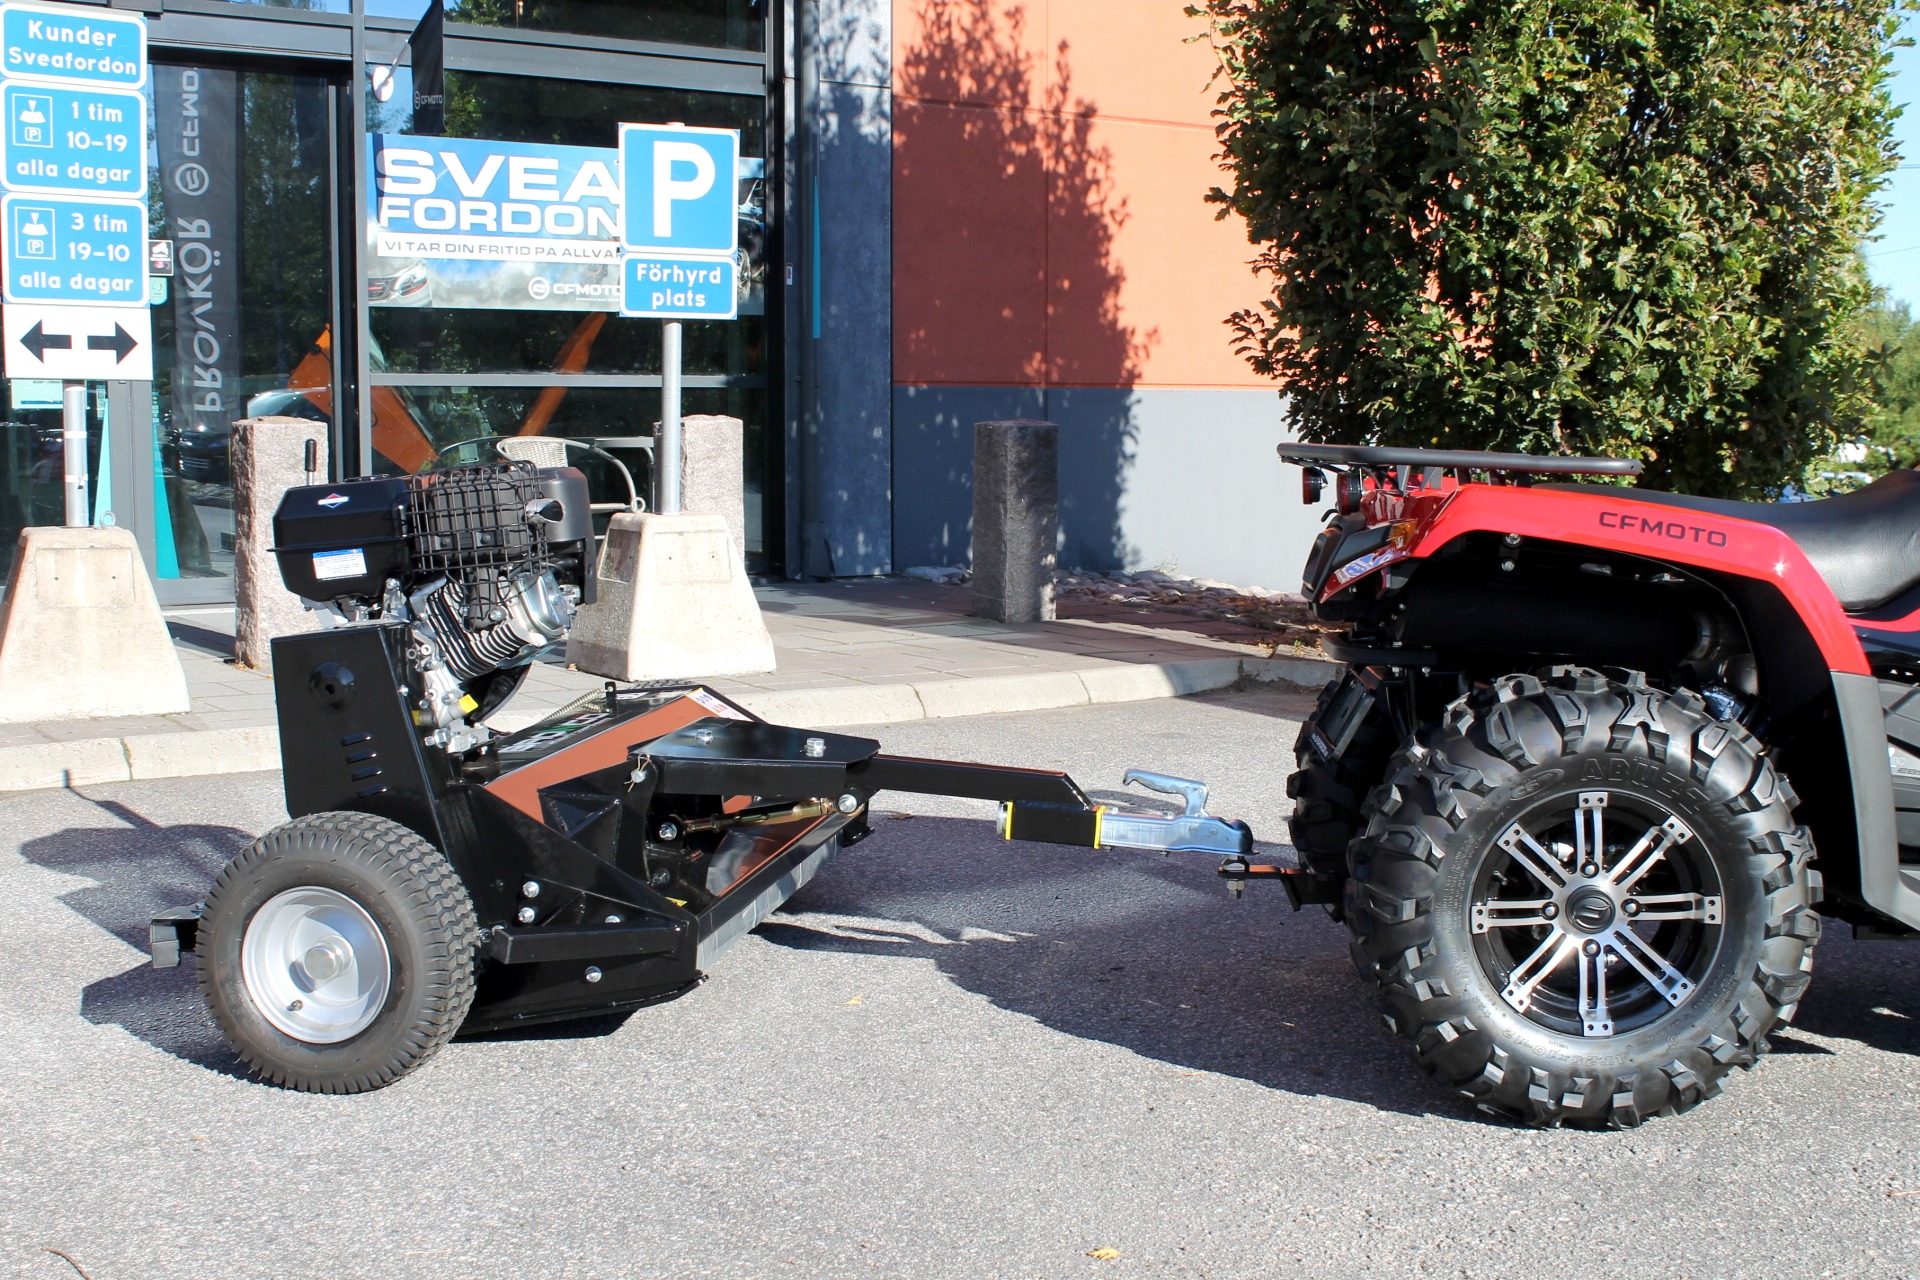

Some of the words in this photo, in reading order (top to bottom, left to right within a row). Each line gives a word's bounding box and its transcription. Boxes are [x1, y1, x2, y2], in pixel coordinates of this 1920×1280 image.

[28, 19, 118, 46] Kunder
[8, 47, 137, 76] Sveafordon
[72, 101, 79, 119] 1
[88, 102, 123, 123] tim
[66, 130, 128, 153] 10-19
[16, 159, 59, 178] alla
[66, 161, 132, 185] dagar
[376, 148, 620, 206] SVEA
[653, 140, 716, 238] P
[70, 213, 84, 231] 3
[93, 213, 128, 233] tim
[377, 196, 620, 237] FORDON
[68, 242, 131, 263] 19-10
[445, 243, 474, 254] DIN
[478, 244, 530, 256] FRITID
[19, 271, 62, 290] alla
[69, 273, 134, 295] dagar
[637, 263, 721, 286] Förhyrd
[651, 286, 706, 310] plats
[1599, 511, 1727, 547] CFMOTO
